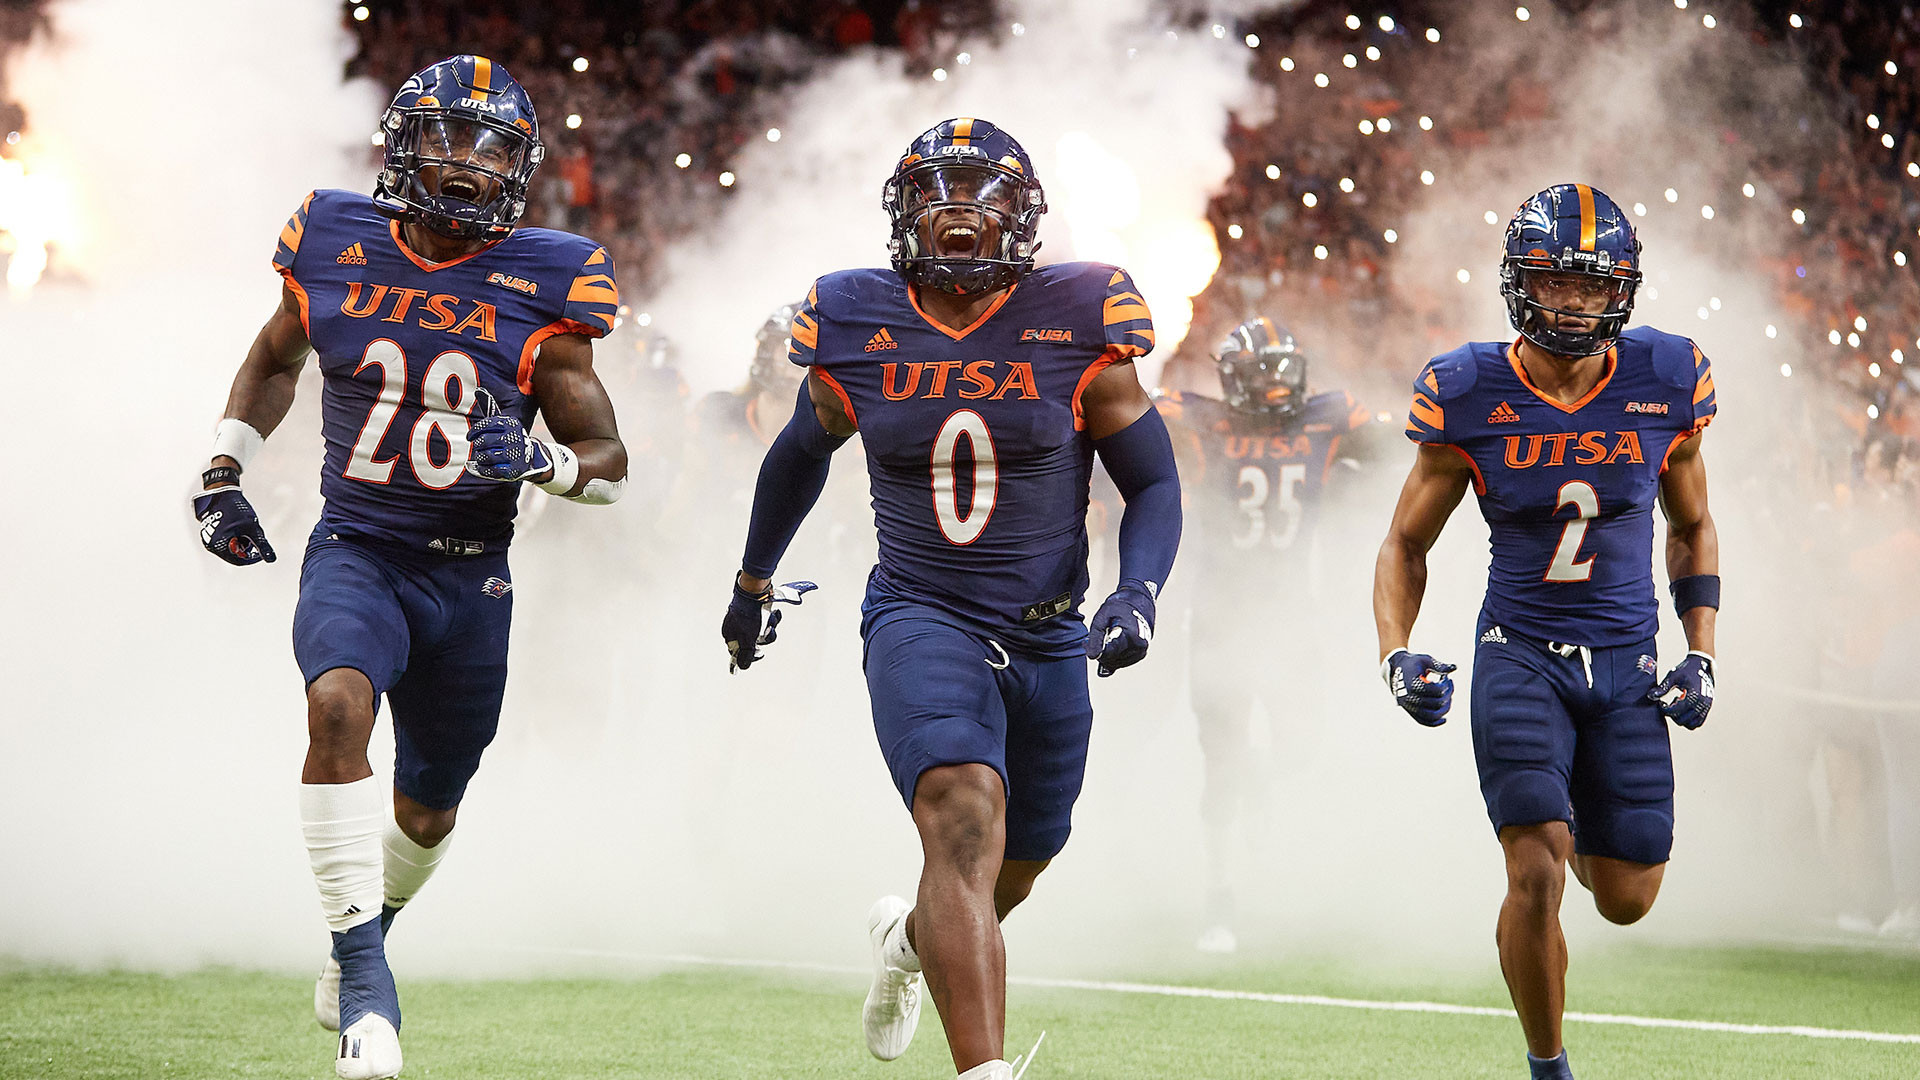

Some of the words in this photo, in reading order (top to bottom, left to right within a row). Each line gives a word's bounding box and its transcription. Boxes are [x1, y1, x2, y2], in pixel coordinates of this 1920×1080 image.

[460, 98, 497, 114] UTSA
[941, 146, 979, 155] UTSA
[336, 255, 368, 266] adidas
[1574, 252, 1597, 261] UTSA
[341, 281, 498, 343] UTSA
[864, 341, 898, 353] adidas
[880, 360, 1041, 401] UTSA
[342, 337, 480, 491] 28
[1487, 414, 1520, 424] adidas
[1224, 434, 1312, 460] UTSA
[1503, 431, 1645, 470] UTSA
[930, 408, 999, 546] 0
[1232, 463, 1306, 548] 35
[1543, 479, 1601, 583] 2
[1480, 635, 1508, 645] adidas
